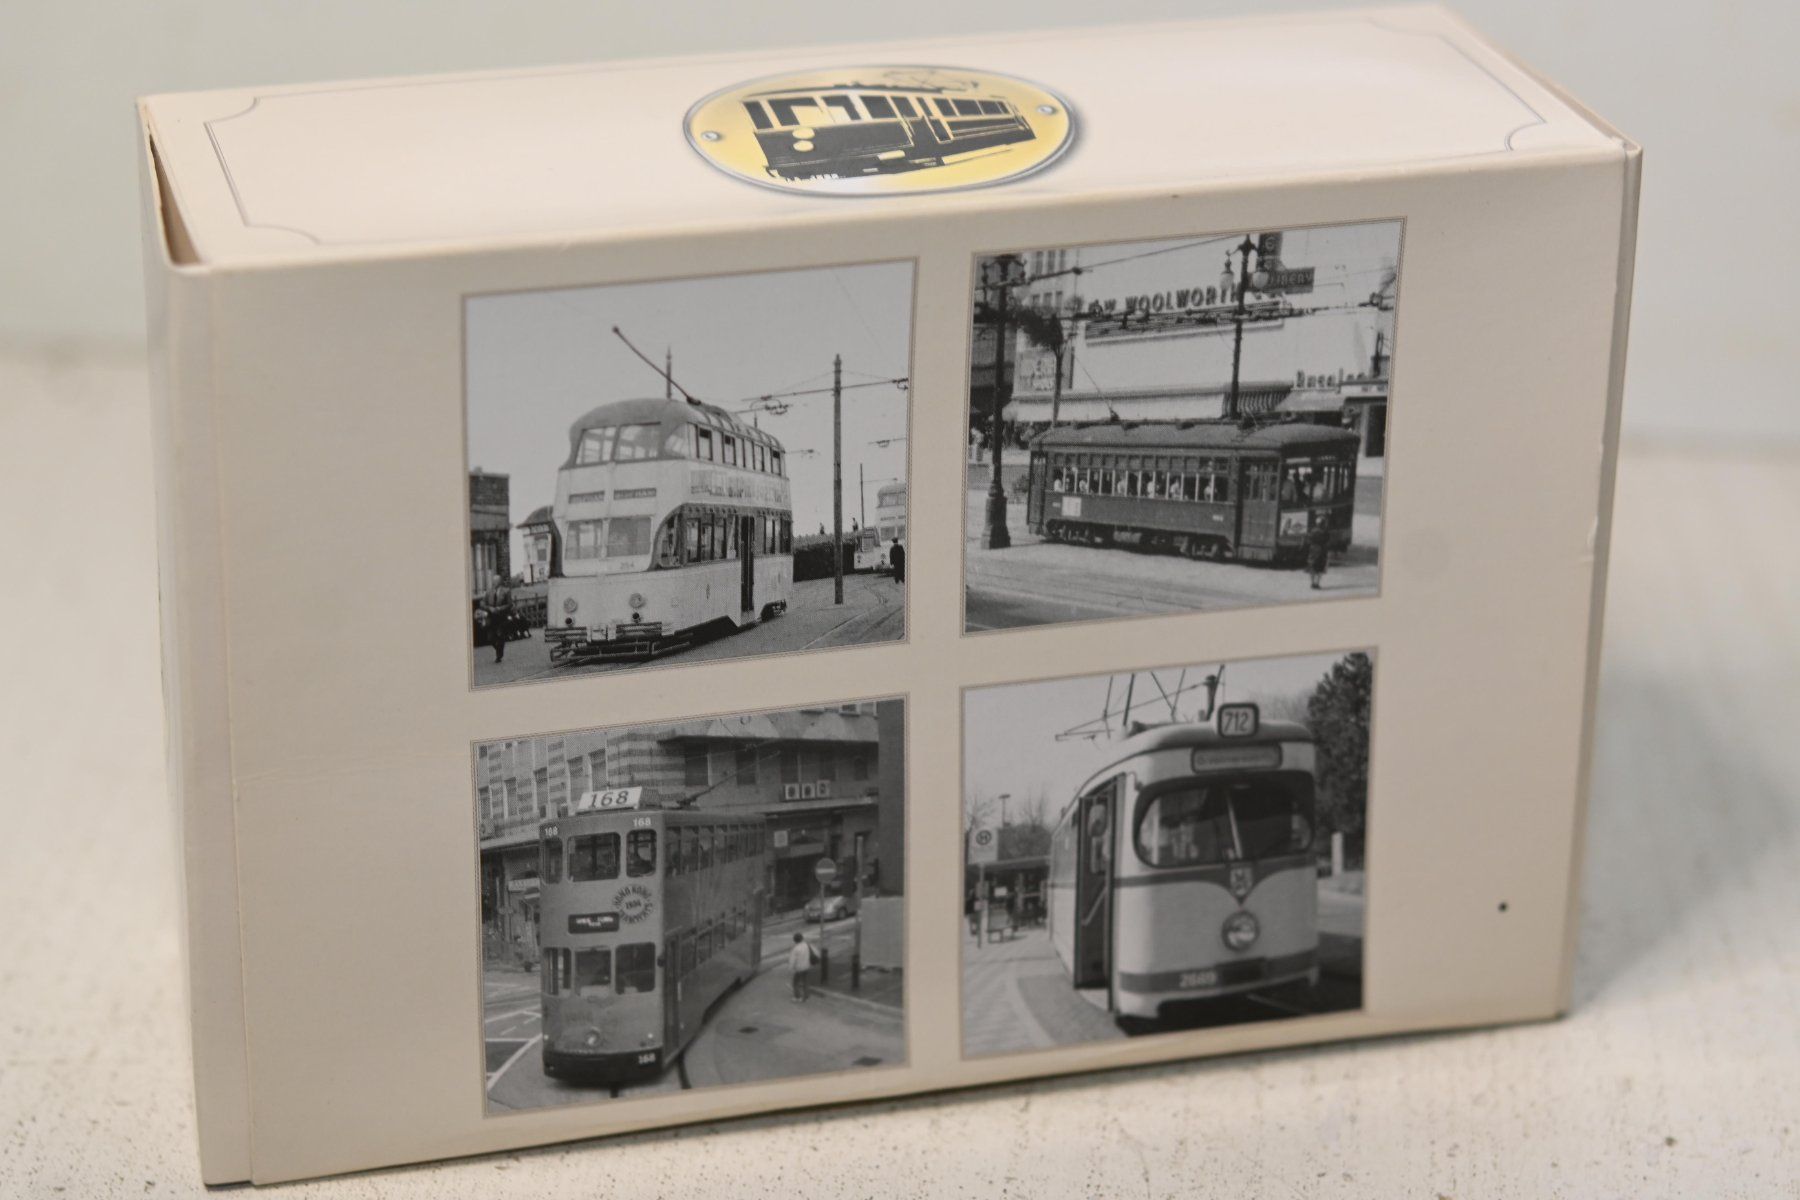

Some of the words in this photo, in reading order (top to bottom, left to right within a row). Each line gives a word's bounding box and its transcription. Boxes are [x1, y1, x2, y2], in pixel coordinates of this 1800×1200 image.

[1224, 711, 1250, 732] 712
[589, 790, 629, 809] 168
[632, 817, 652, 828] 168
